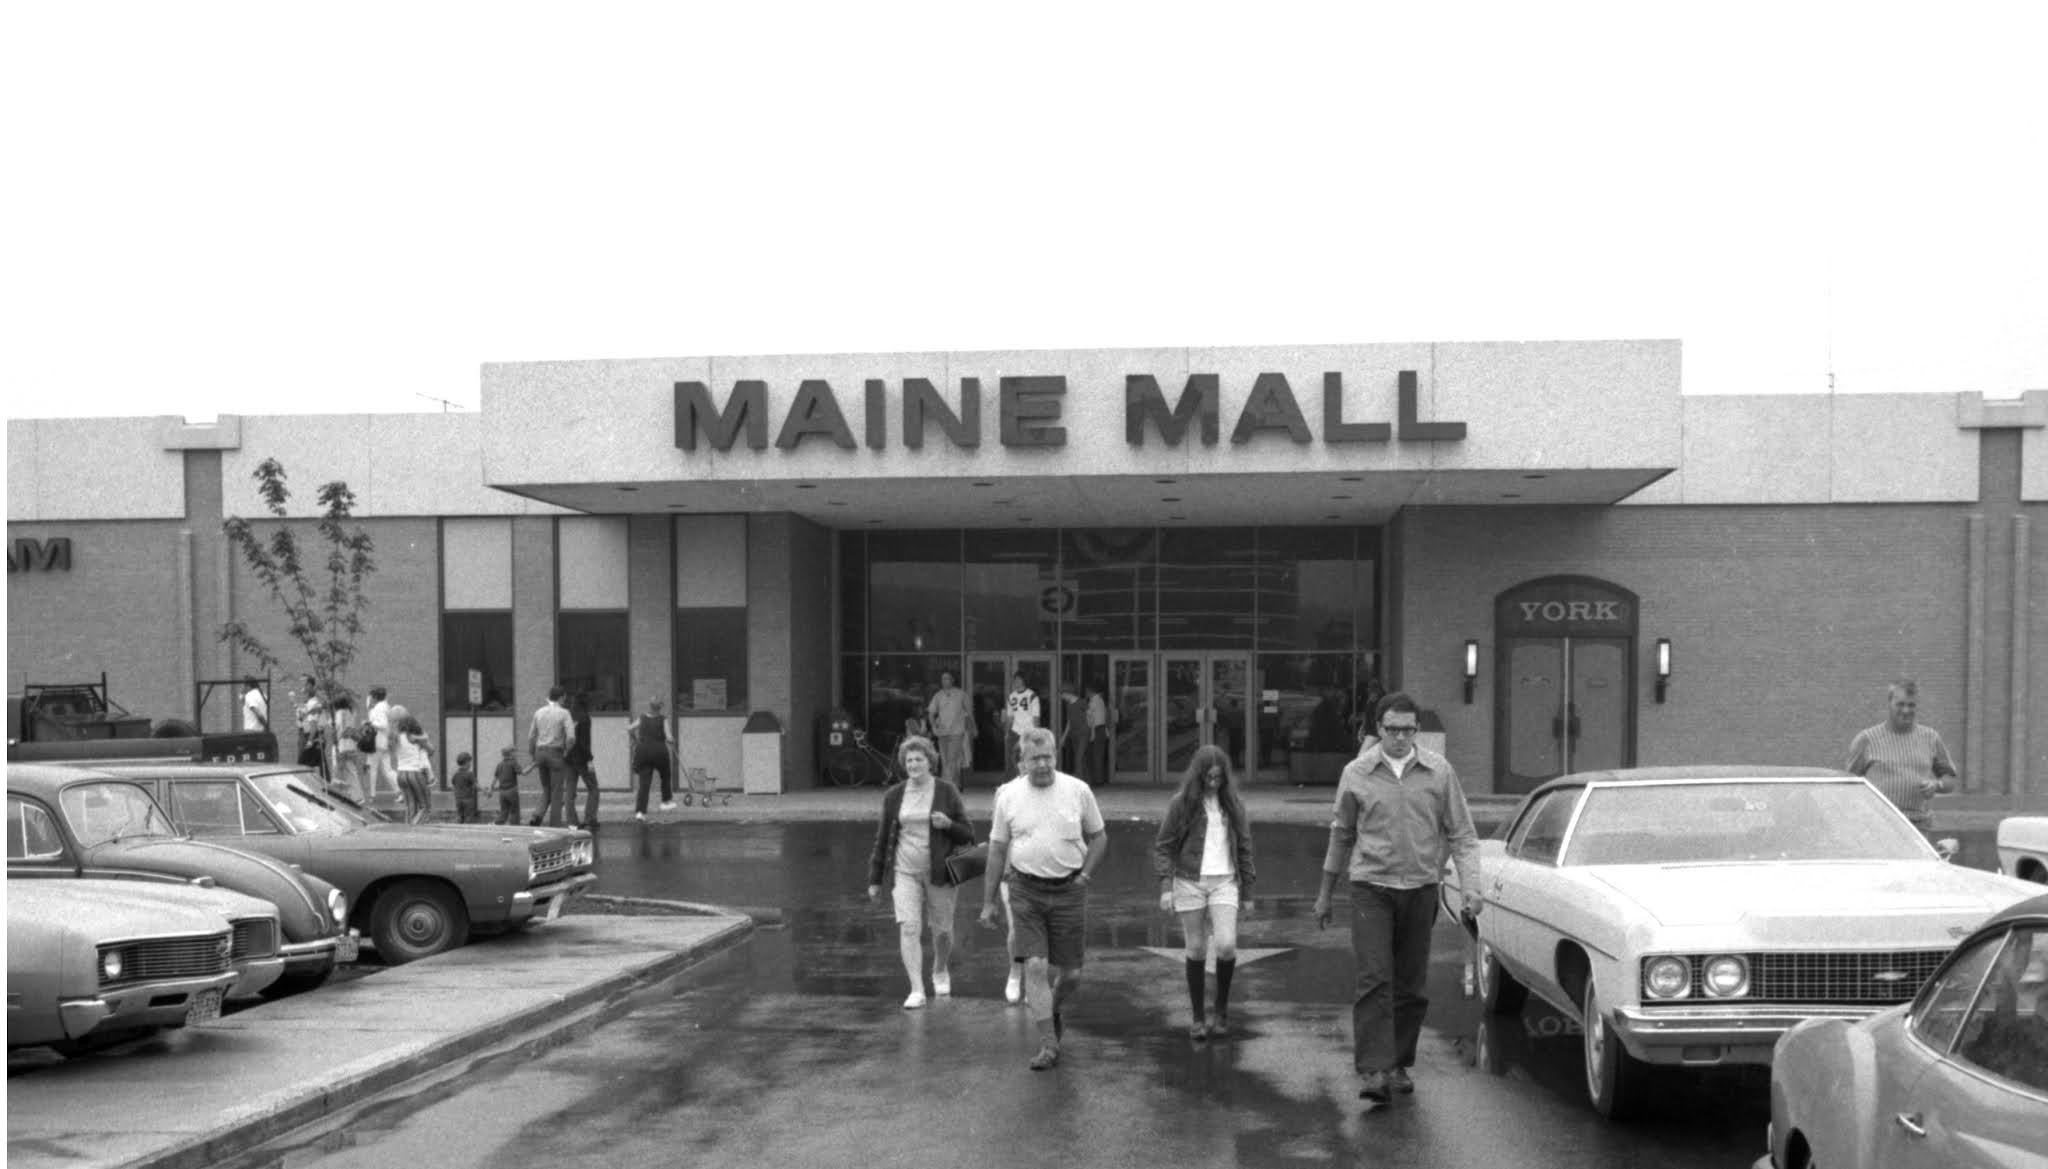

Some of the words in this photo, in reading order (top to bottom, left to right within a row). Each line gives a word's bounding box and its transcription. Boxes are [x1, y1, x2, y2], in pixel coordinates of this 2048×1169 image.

[674, 375, 1067, 450] MAINE
[1126, 370, 1467, 445] MALL
[1520, 601, 1619, 621] YORK
[1010, 697, 1028, 711] 24
[212, 752, 265, 763] FORD
